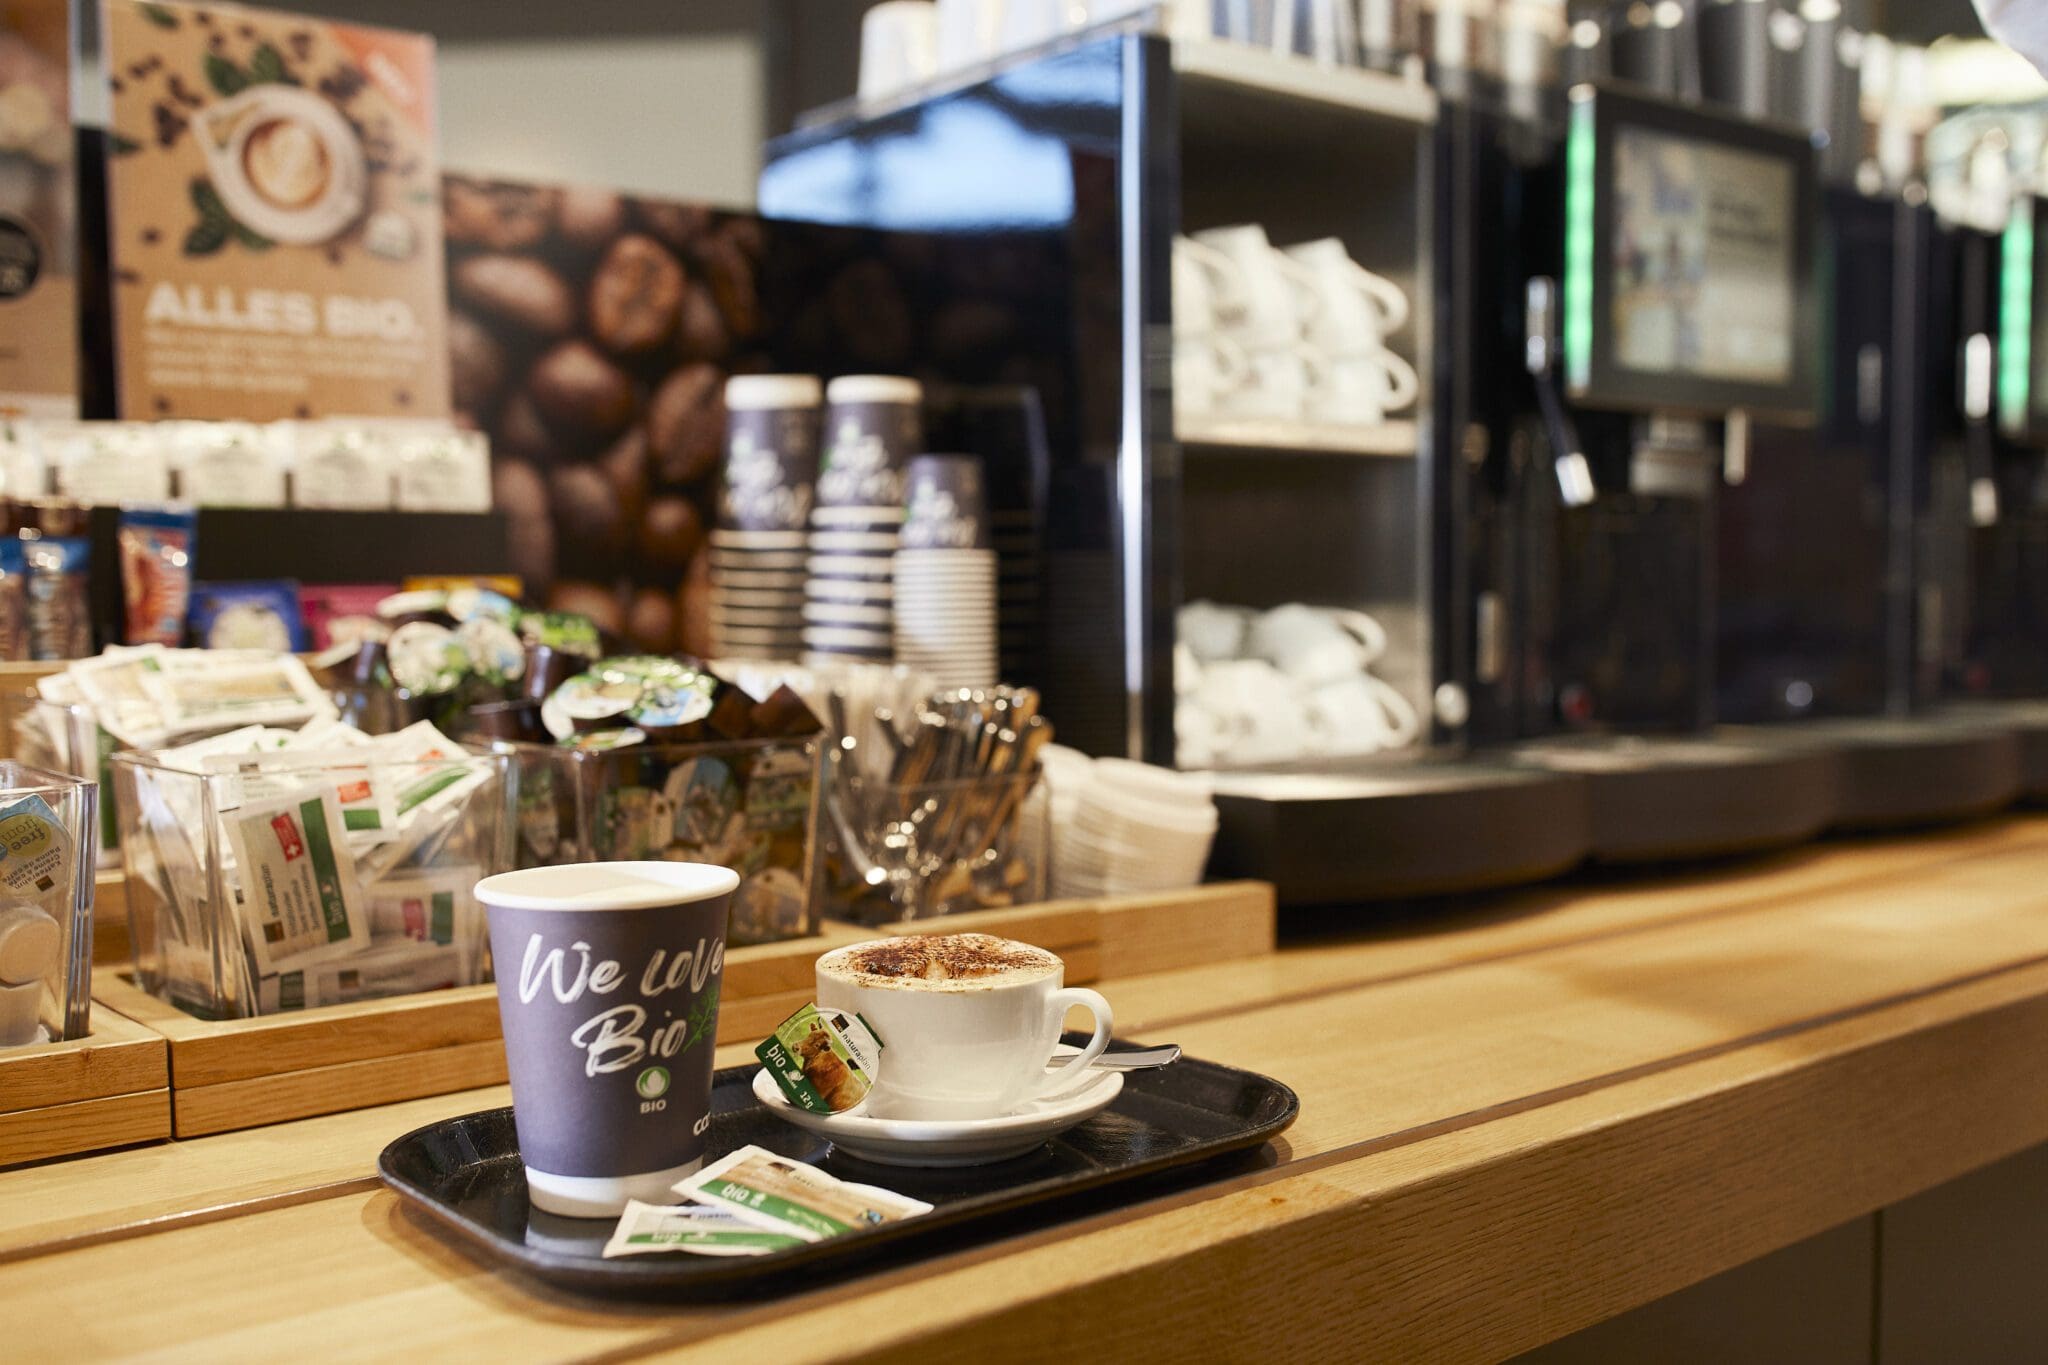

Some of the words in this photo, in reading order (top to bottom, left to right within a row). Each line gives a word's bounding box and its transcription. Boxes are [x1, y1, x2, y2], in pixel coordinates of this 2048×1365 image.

[145, 282, 317, 334] ALLES
[11, 828, 45, 851] free
[519, 933, 629, 1004] We
[571, 1004, 687, 1077] Bio
[766, 1043, 787, 1069] bio
[841, 1033, 872, 1071] naturaplan
[640, 1099, 667, 1114] BIO
[720, 1182, 750, 1202] bio
